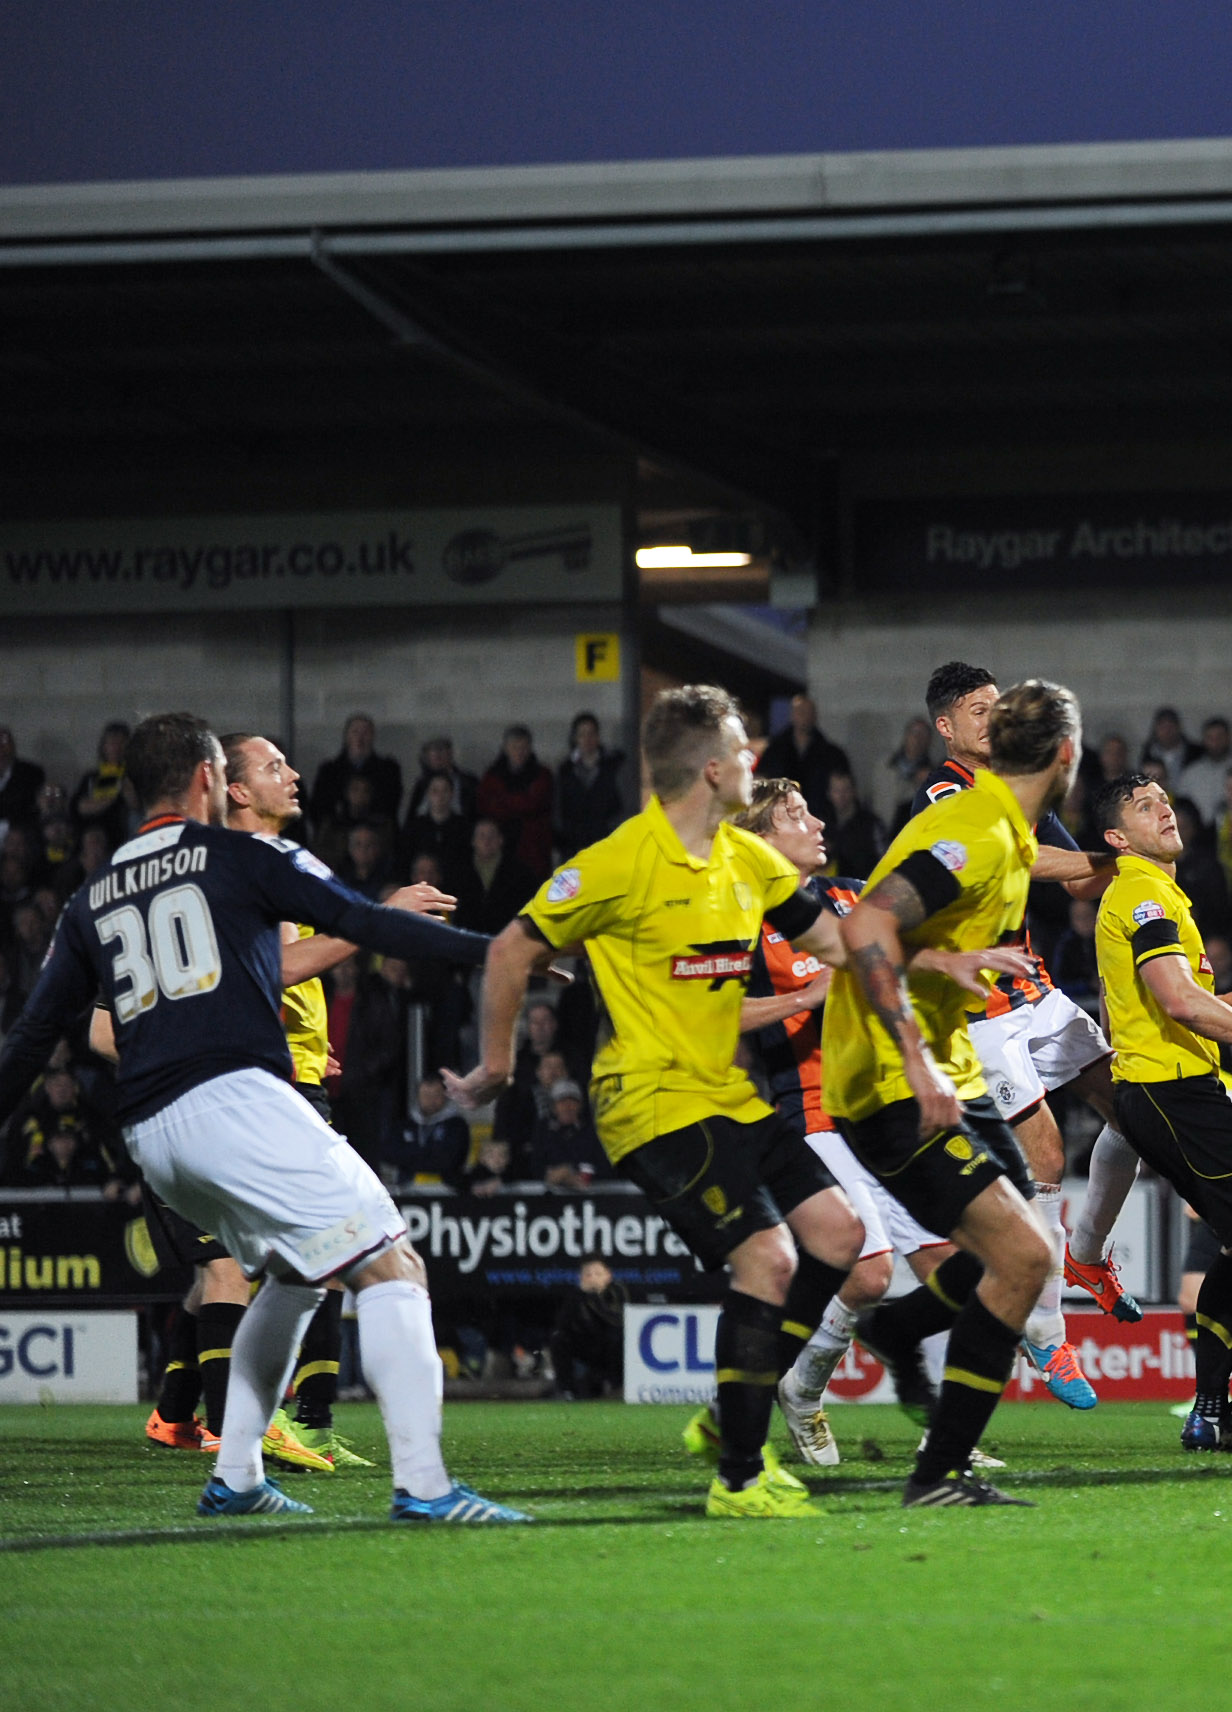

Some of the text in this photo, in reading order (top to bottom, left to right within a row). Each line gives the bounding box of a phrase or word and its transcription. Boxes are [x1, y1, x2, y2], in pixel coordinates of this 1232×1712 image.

[5, 532, 414, 590] www.raygar.co.uk
[926, 523, 1060, 568] Raygar
[585, 642, 607, 674] F
[89, 845, 207, 910] WILKINSON
[94, 882, 222, 1025] 30
[674, 959, 713, 975] Anvil
[403, 1201, 704, 1273] Physiothera
[0, 1247, 101, 1290] ium
